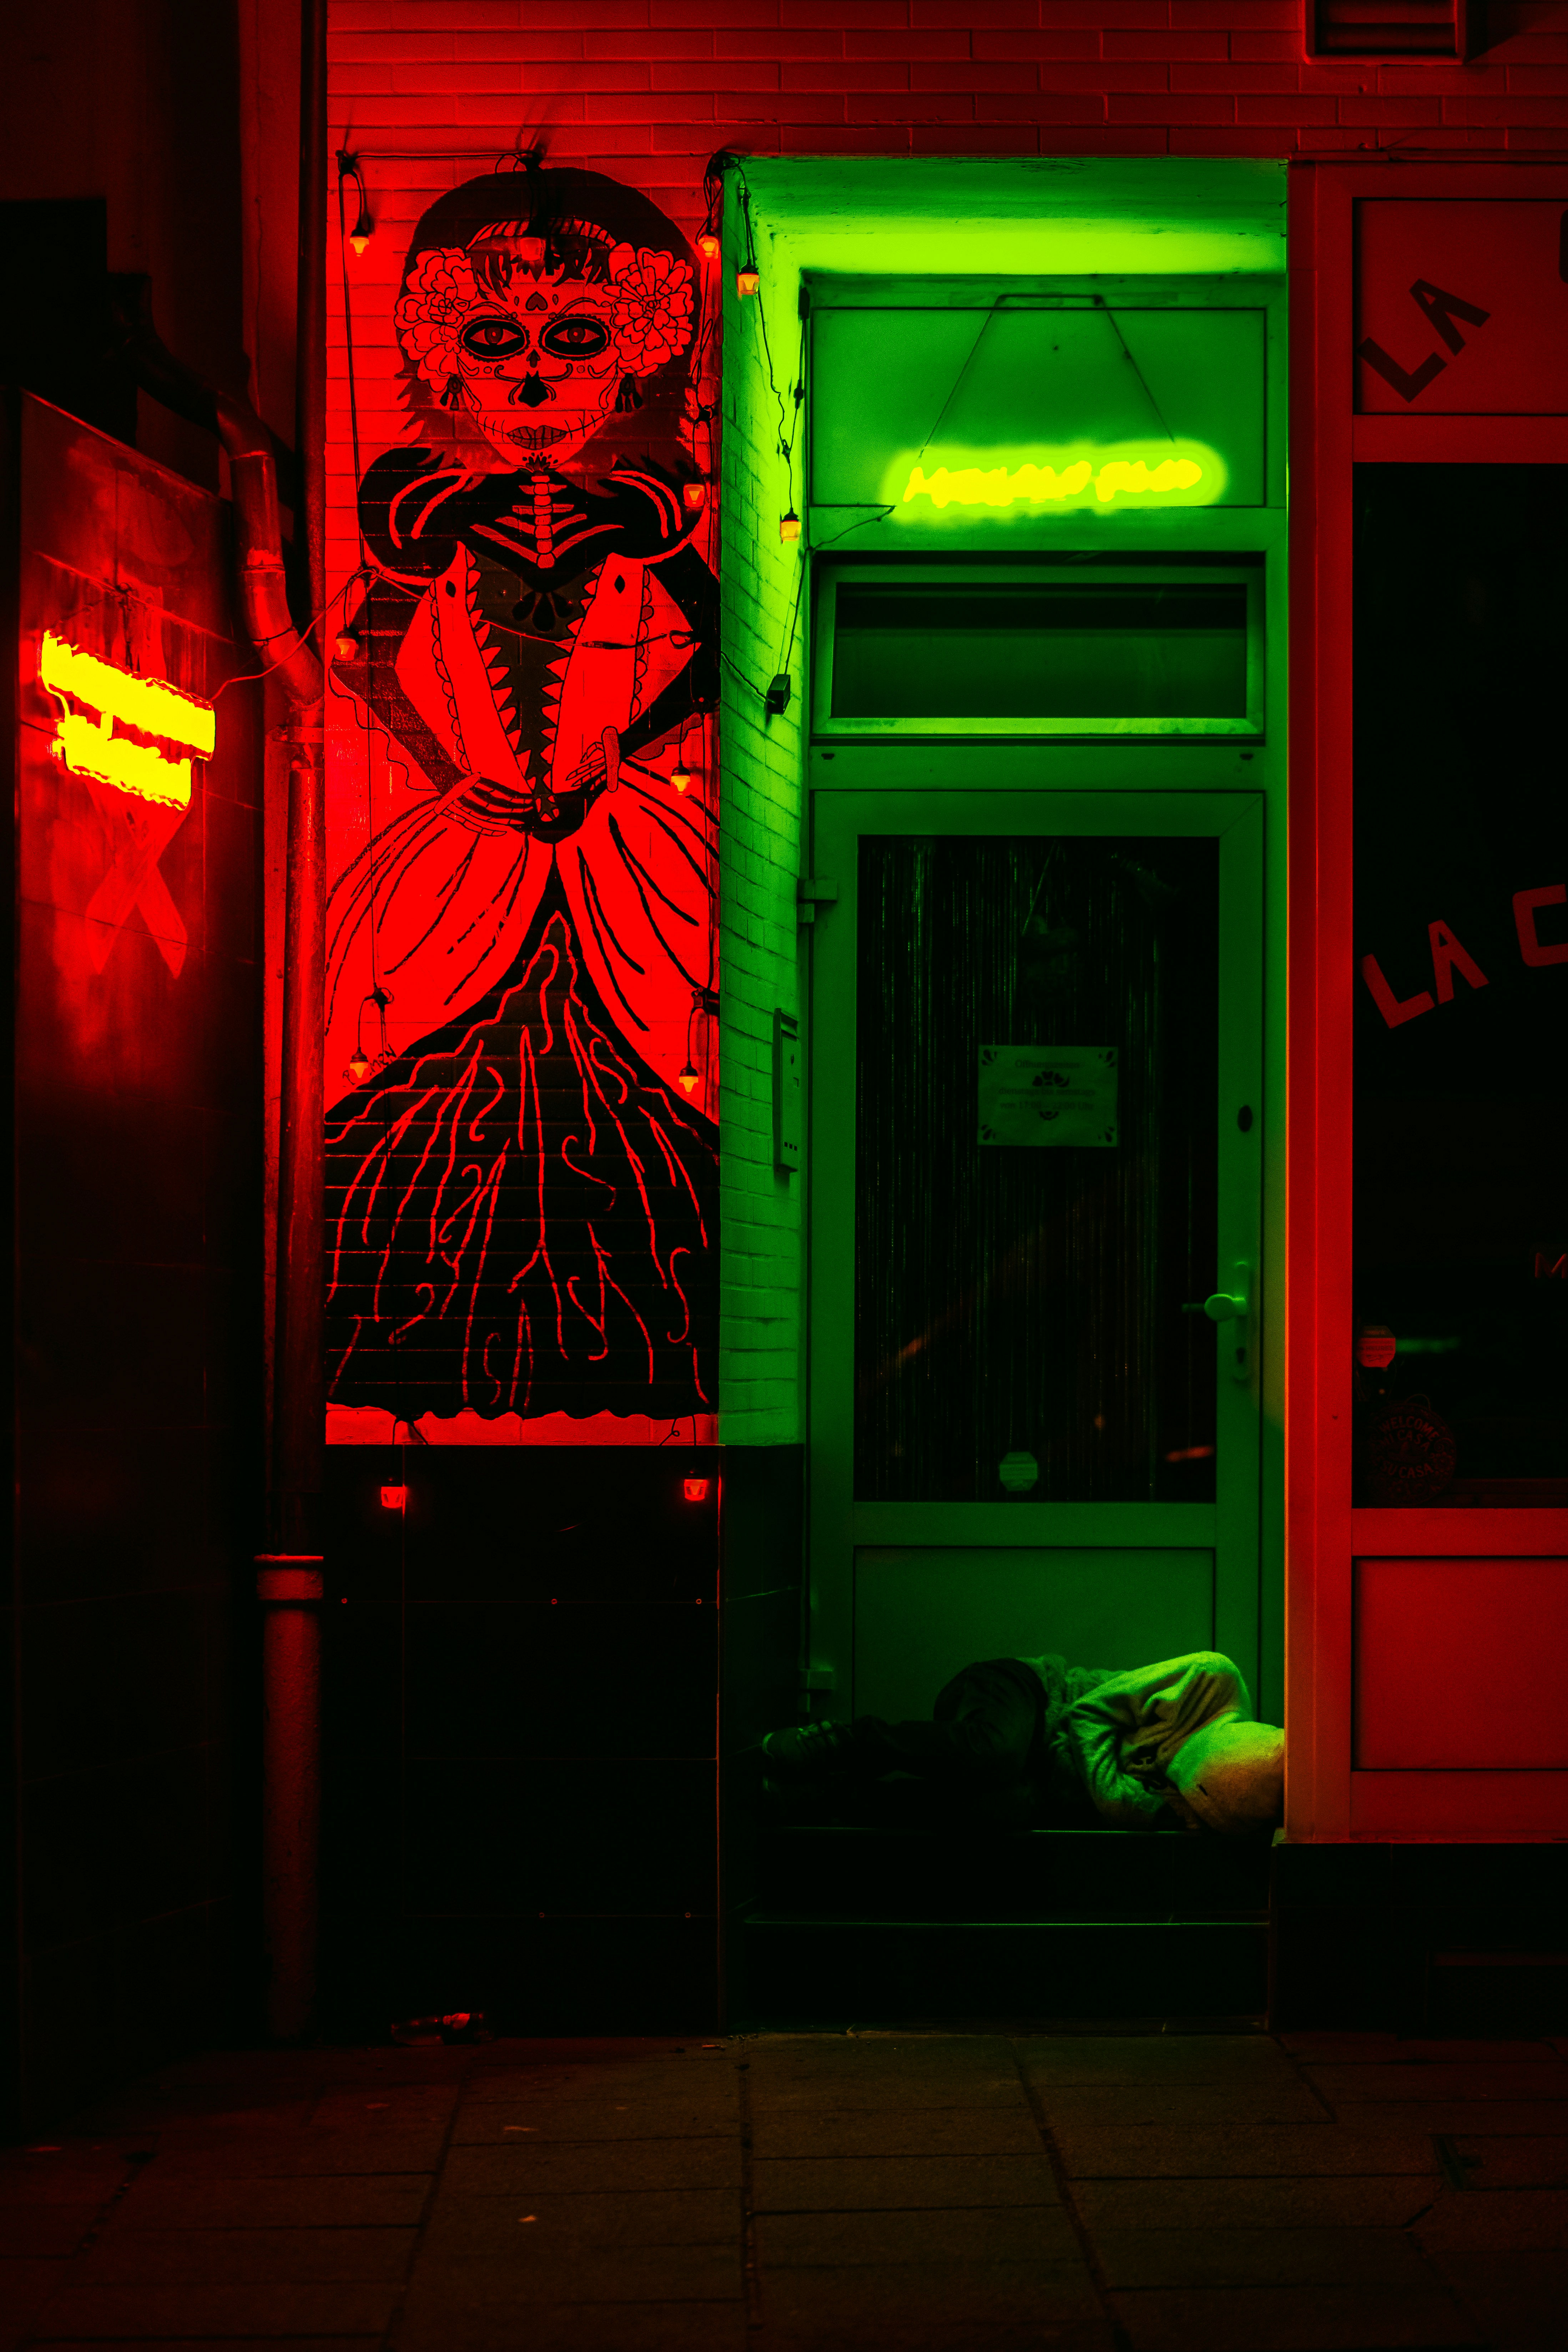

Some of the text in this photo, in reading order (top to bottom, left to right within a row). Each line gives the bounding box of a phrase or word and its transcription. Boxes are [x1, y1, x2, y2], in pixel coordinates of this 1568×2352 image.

[1357, 278, 1491, 403] LA
[1358, 919, 1490, 1029] LA
[999, 1087, 1039, 1097] dienstags
[1056, 1088, 1095, 1097] samstags
[1377, 1415, 1440, 1441] WELCOME
[1397, 1429, 1430, 1452] CASA
[1380, 1460, 1434, 1479] SU CASA
